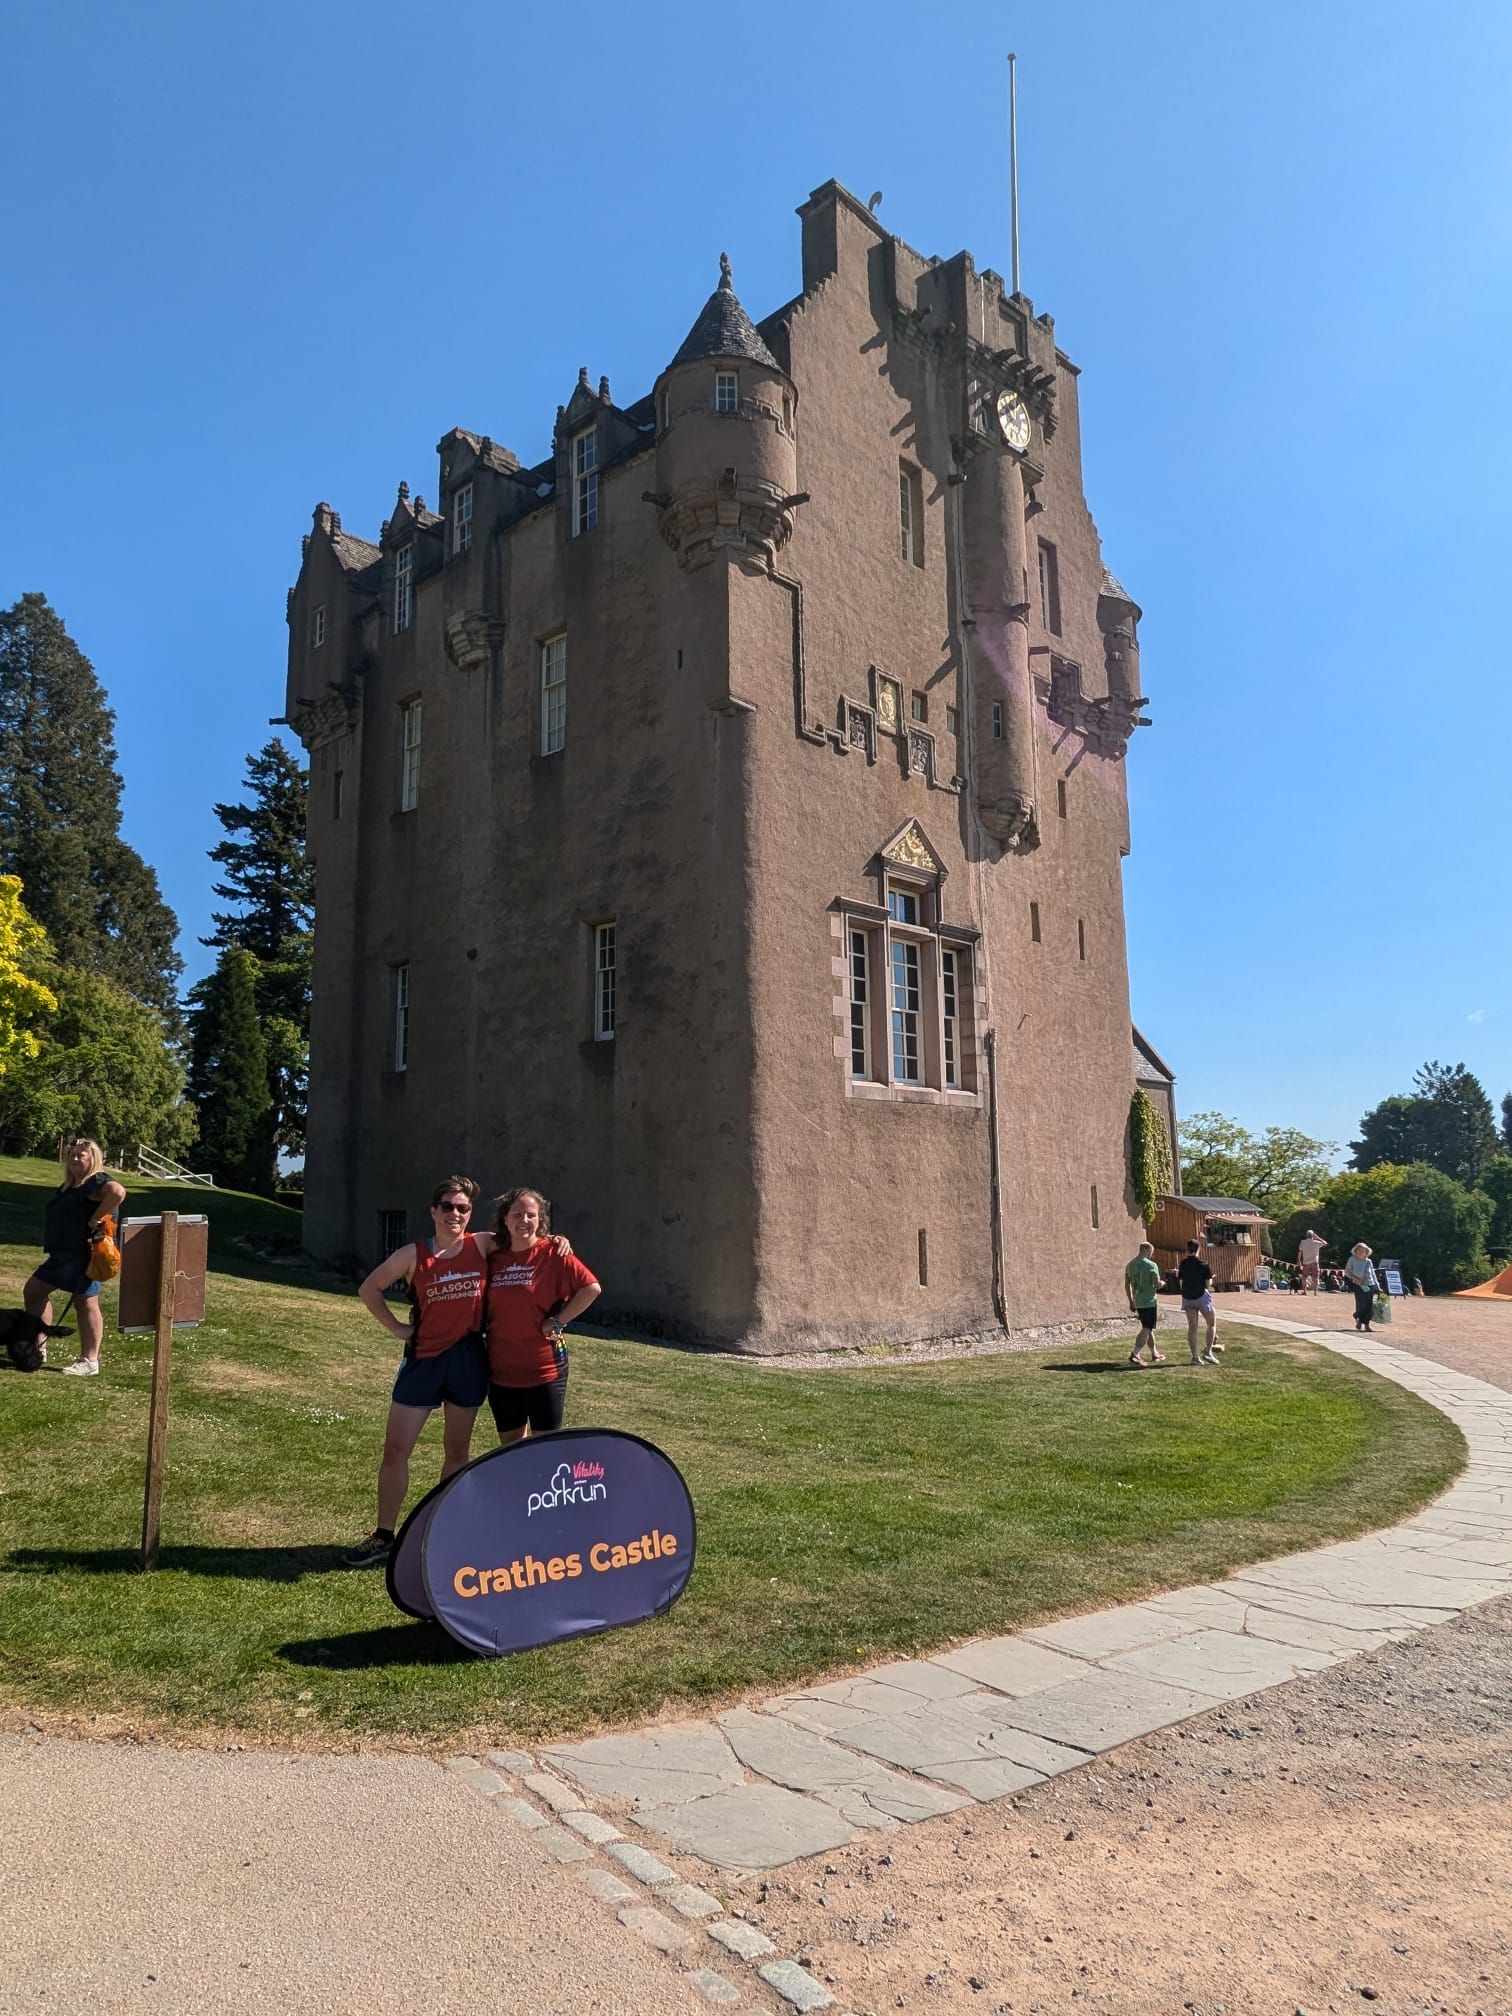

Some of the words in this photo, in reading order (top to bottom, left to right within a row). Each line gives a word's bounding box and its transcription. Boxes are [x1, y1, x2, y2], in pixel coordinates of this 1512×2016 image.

[492, 1270, 534, 1282] GLASGOW
[426, 1279, 480, 1297] GLASGOW
[572, 1460, 605, 1479] Vitality
[527, 1478, 607, 1517] parkrun
[453, 1553, 582, 1598] Crathes
[589, 1530, 677, 1571] Castle
